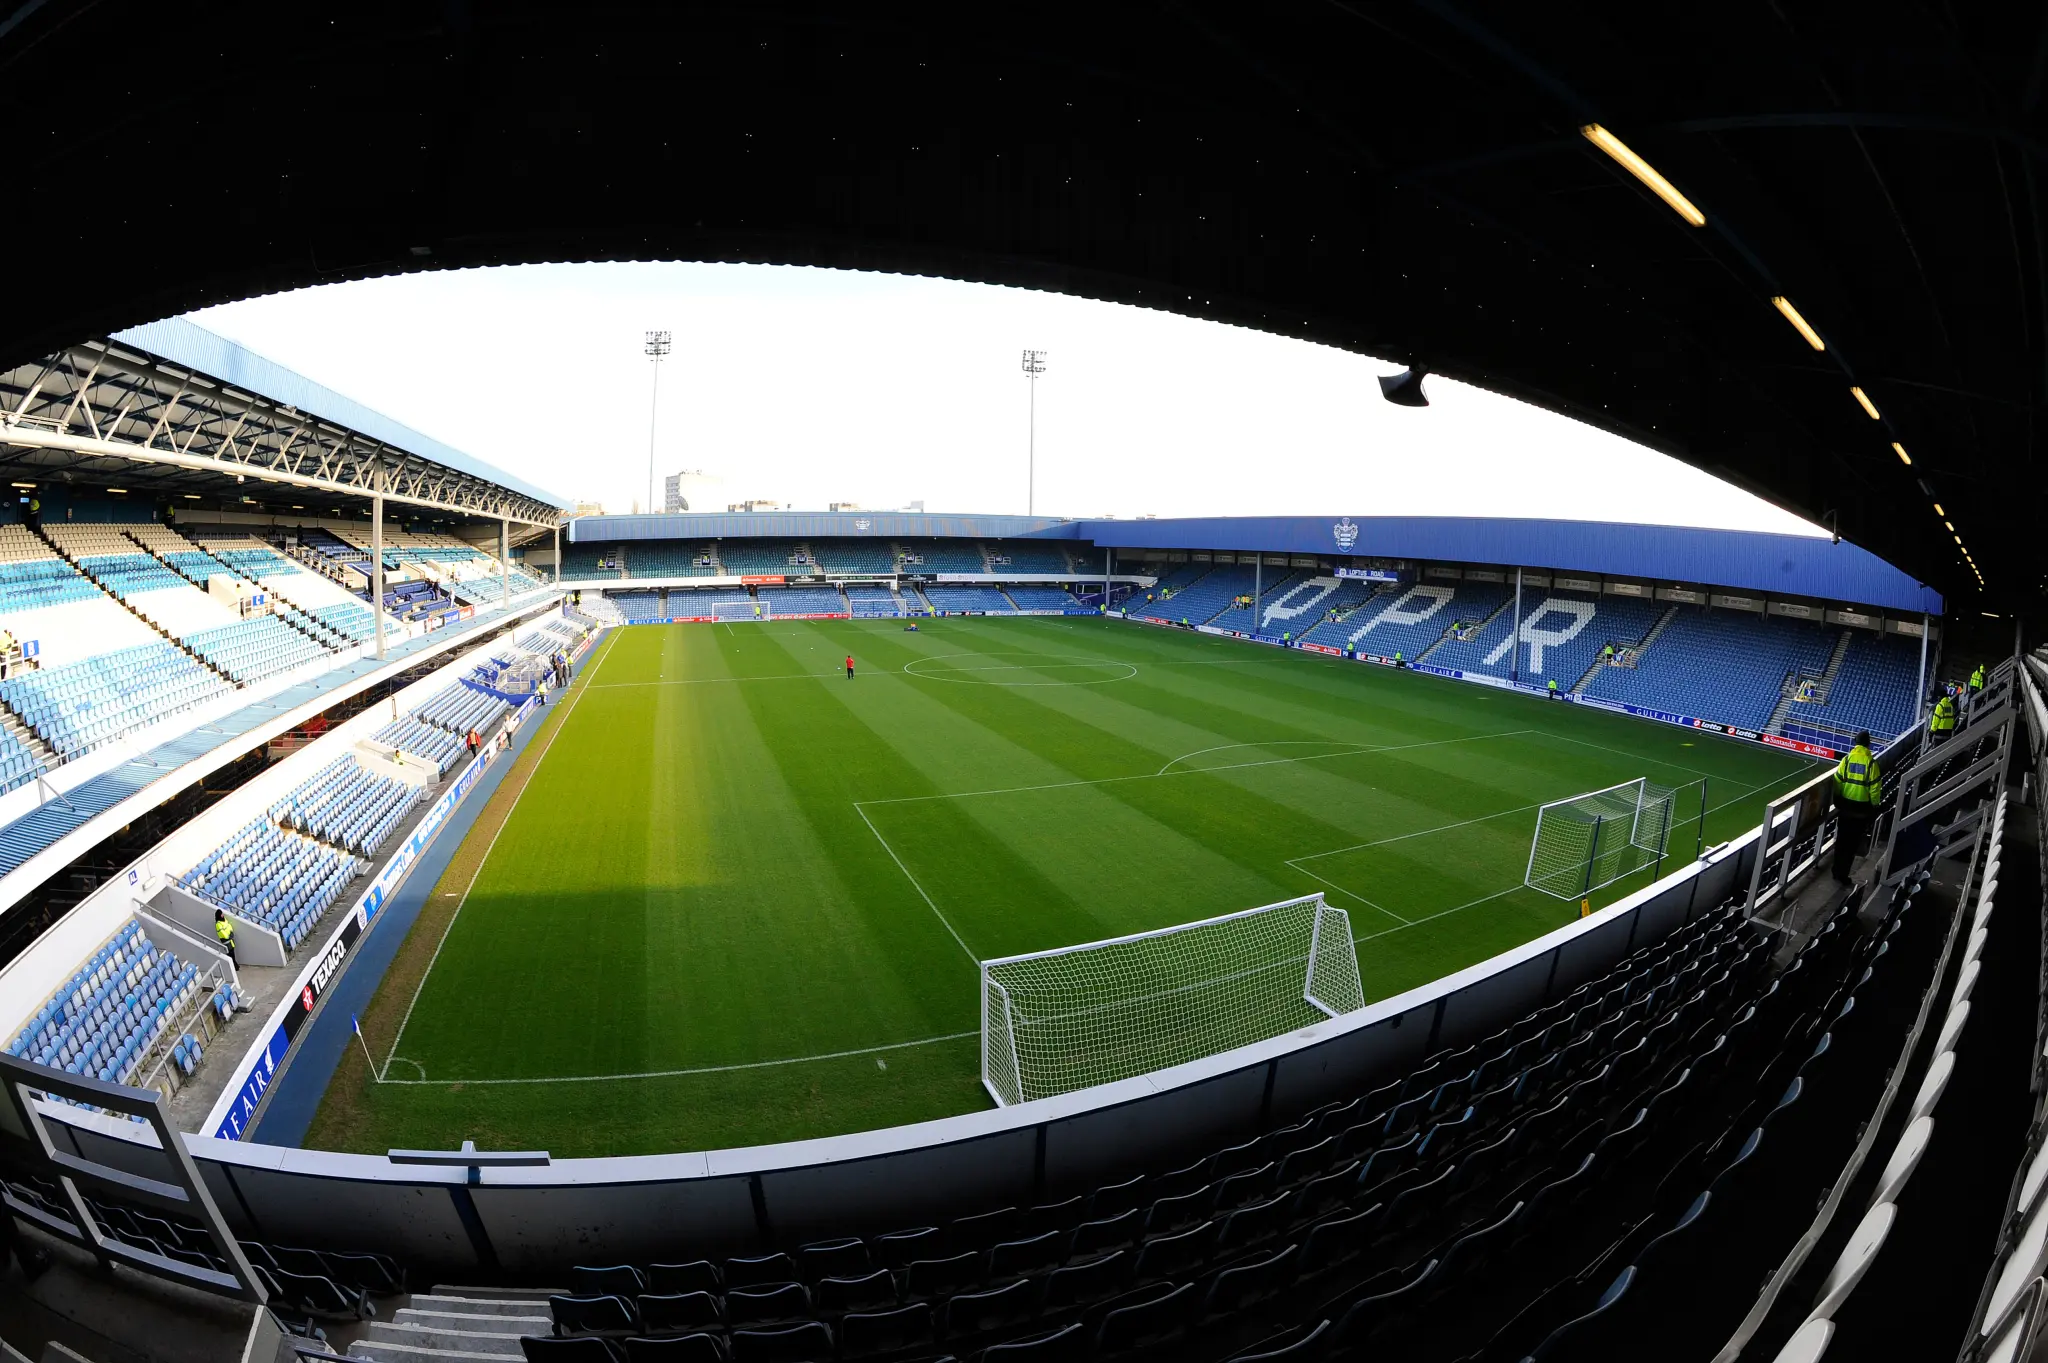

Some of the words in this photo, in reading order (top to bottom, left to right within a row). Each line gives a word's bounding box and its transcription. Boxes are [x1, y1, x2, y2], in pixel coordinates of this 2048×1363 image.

[1349, 569, 1367, 577] LOFTUS
[28, 642, 36, 656] B
[1419, 665, 1437, 674] GULF
[1636, 708, 1659, 720] GULF
[1661, 713, 1676, 723] AIR
[1769, 736, 1797, 749] Santander
[1810, 746, 1829, 756] Abbey
[311, 939, 347, 995] TEXACO
[242, 1070, 267, 1119] AIR
